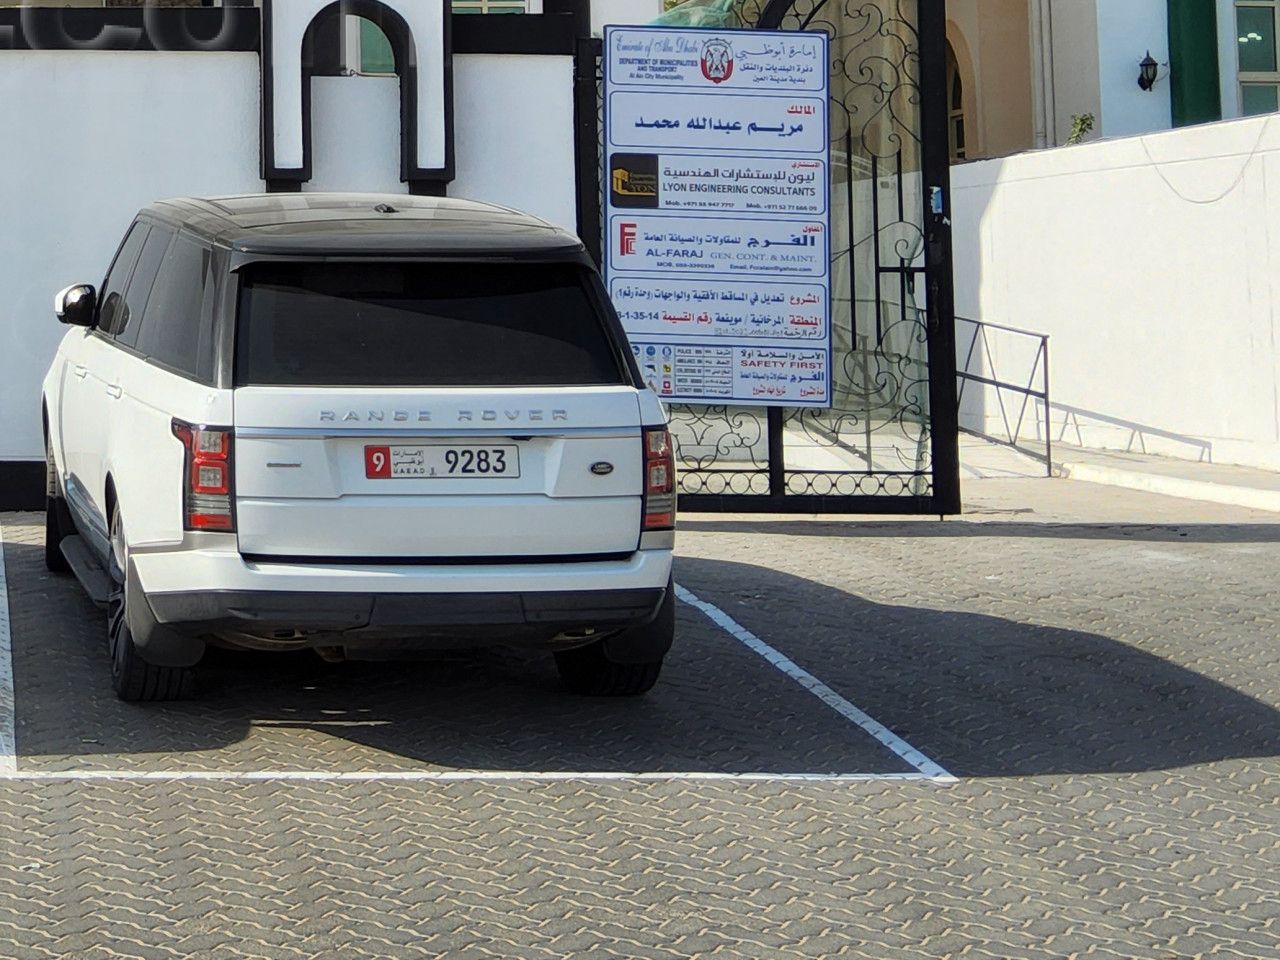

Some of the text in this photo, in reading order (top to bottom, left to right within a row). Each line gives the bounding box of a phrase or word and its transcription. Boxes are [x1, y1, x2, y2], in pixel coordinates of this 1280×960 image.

[787, 104, 816, 115] المالك
[634, 116, 680, 129] محمد
[747, 122, 804, 136] مريم
[663, 167, 720, 179] الهندسية
[788, 172, 815, 184] ليون
[662, 183, 816, 197] LYON ENGINEERING CONSULTANTS
[747, 234, 815, 248] الفرج
[645, 248, 704, 259] AL-FARAJ
[749, 291, 759, 305] في
[760, 293, 785, 305] تعديل
[789, 293, 820, 306] المشروع
[697, 310, 713, 324] رقم
[789, 313, 822, 327] المنطقة
[740, 359, 786, 369] SAFETY
[790, 361, 824, 370] FIRST
[458, 410, 570, 422] ROVER
[372, 452, 385, 472] 9
[445, 449, 506, 474] 9283
